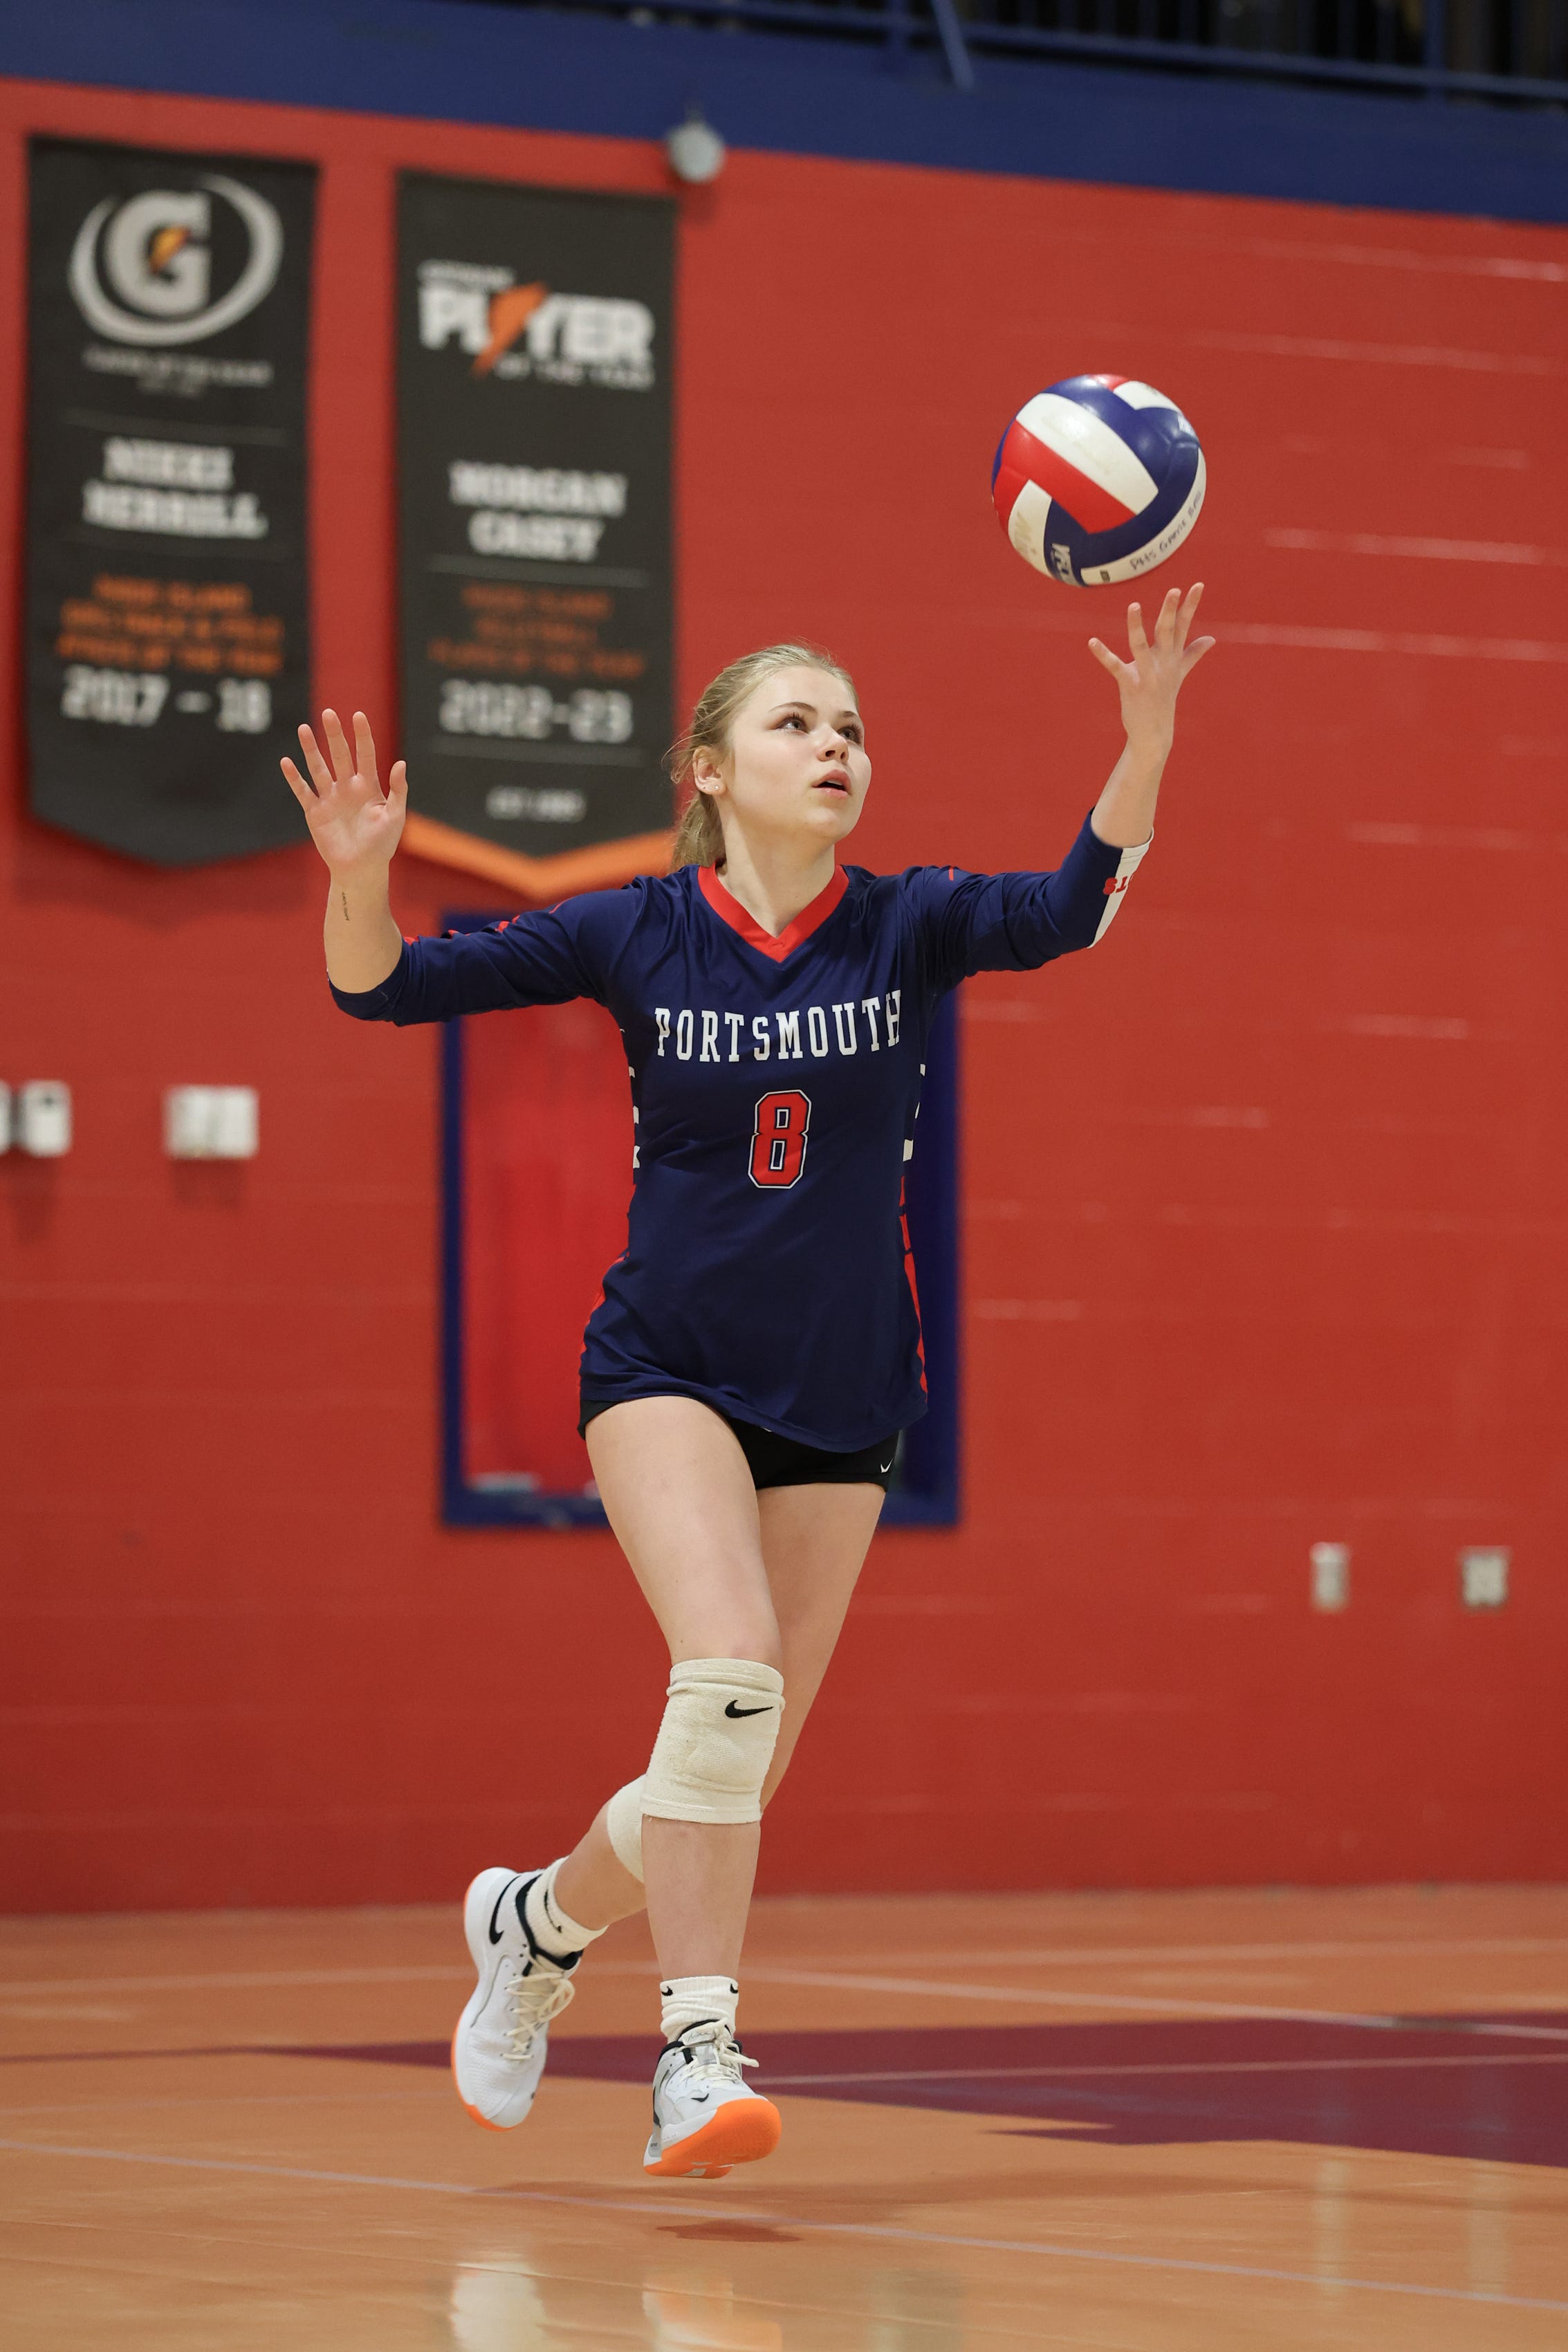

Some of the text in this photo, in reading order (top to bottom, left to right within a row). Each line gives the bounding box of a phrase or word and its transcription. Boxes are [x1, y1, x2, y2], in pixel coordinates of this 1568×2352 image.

[64, 667, 168, 726] 2017
[654, 989, 901, 1063] PORTSMOUTH
[748, 1089, 812, 1189] 8
